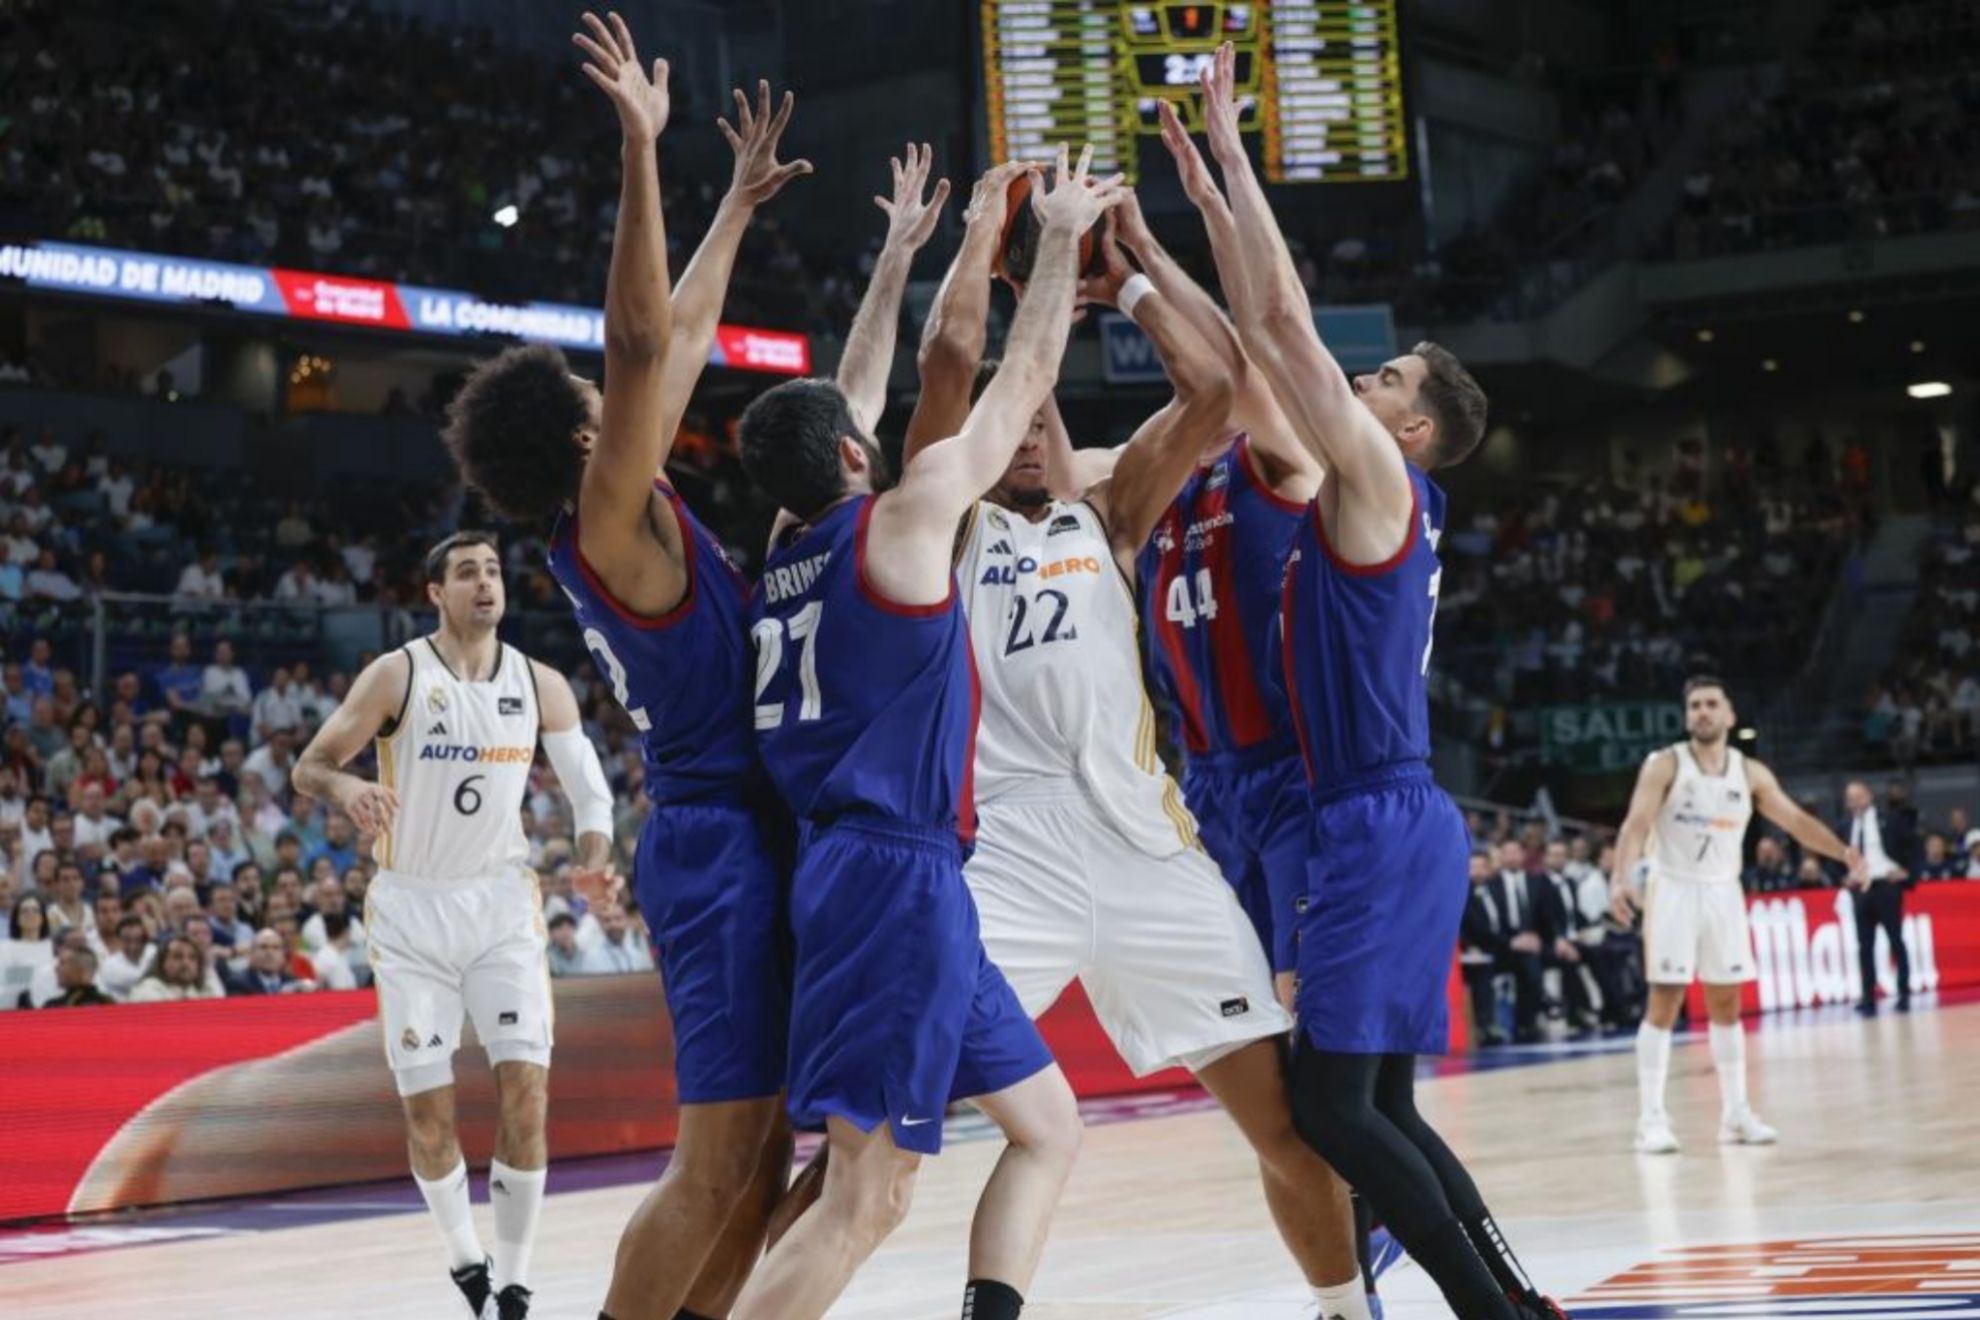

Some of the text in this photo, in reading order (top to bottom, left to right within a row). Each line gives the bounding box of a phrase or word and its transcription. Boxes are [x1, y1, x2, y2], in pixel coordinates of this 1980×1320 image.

[122, 260, 157, 292] DE
[162, 265, 265, 304] MADRID
[420, 297, 452, 326] LA
[1166, 567, 1218, 628] 44
[1003, 589, 1078, 657] 22
[1553, 706, 1682, 745] SALID
[419, 743, 532, 763] AUTOHERO
[454, 775, 486, 816] 6
[1695, 833, 1712, 863] 7
